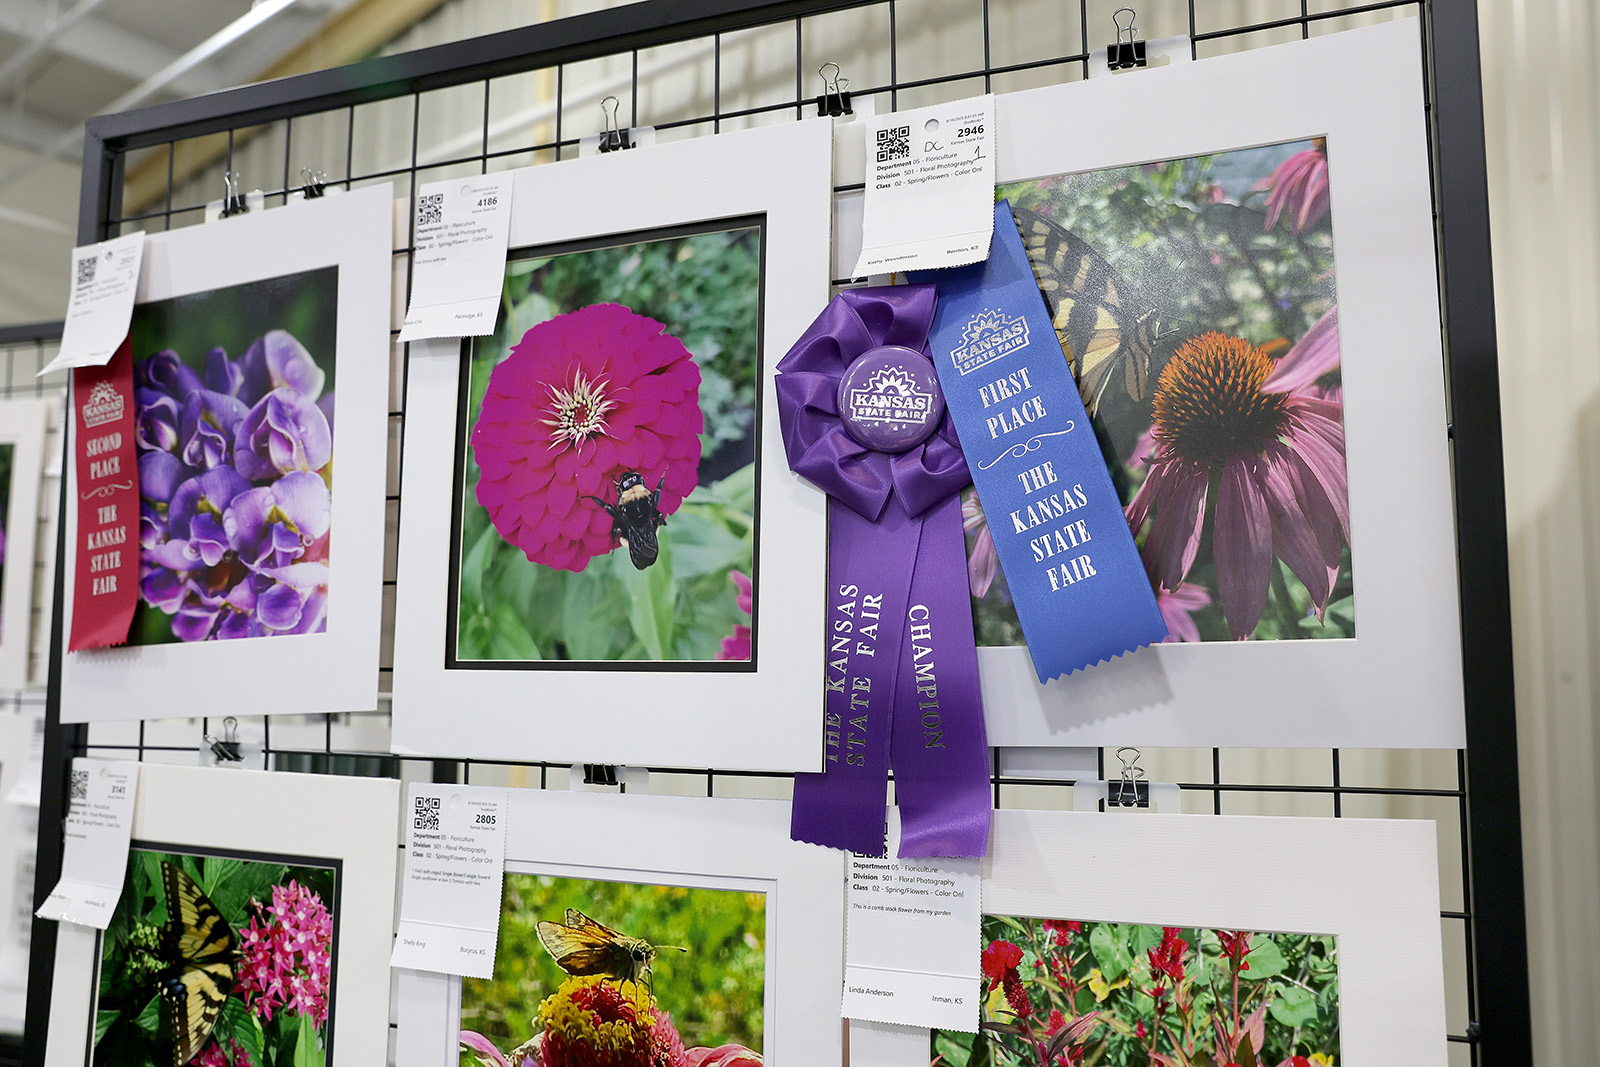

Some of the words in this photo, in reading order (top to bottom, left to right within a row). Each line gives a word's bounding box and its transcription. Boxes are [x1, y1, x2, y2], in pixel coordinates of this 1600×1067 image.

[957, 124, 985, 138] 2946
[876, 172, 900, 181] Division
[920, 166, 936, 174] Floral
[937, 160, 974, 171] Photography
[877, 161, 912, 171] Department
[926, 153, 957, 162] Floriculture
[876, 182, 891, 190] Class
[907, 173, 949, 185] Spring/Flowers
[954, 169, 971, 177] Color
[972, 166, 983, 174] Onl
[477, 197, 498, 207] 4186
[417, 225, 442, 234] Department
[956, 322, 1024, 364] KANSAS
[963, 350, 996, 370] STATE
[998, 336, 1024, 354] FAIR
[978, 366, 1033, 409] FIRST
[86, 400, 120, 417] KANSAS
[855, 393, 926, 410] KANSAS
[858, 407, 892, 417] STATE
[895, 409, 921, 419] FAIR
[985, 395, 1047, 440] PLACE
[86, 432, 122, 458] SECOND
[90, 456, 120, 480] PLACE
[1017, 461, 1058, 495] THE
[97, 504, 118, 524] THE
[1009, 483, 1088, 535] KANSAS
[87, 525, 127, 550] KANSAS
[1030, 519, 1092, 563] STATE
[90, 551, 122, 573] STATE
[1046, 554, 1097, 593] FAIR
[92, 575, 118, 596] FAIR
[856, 593, 883, 658] FAIR
[828, 584, 859, 694] KANSAS
[908, 604, 946, 749] CHAMPION
[846, 676, 872, 767] STATE
[475, 814, 496, 824] 2805
[414, 832, 440, 840] Department
[435, 853, 468, 862] Spring/Flowers
[459, 846, 487, 854] Photography
[853, 861, 890, 870] Department
[904, 864, 938, 873] Floriculture
[853, 873, 878, 881] Division
[916, 877, 956, 887] Photography
[885, 886, 929, 895] Spring/Flowers
[934, 889, 951, 897] Color
[849, 986, 865, 994] Linda
[865, 988, 894, 997] Anderson
[932, 995, 953, 1005] Inman,
[954, 997, 963, 1005] KS
